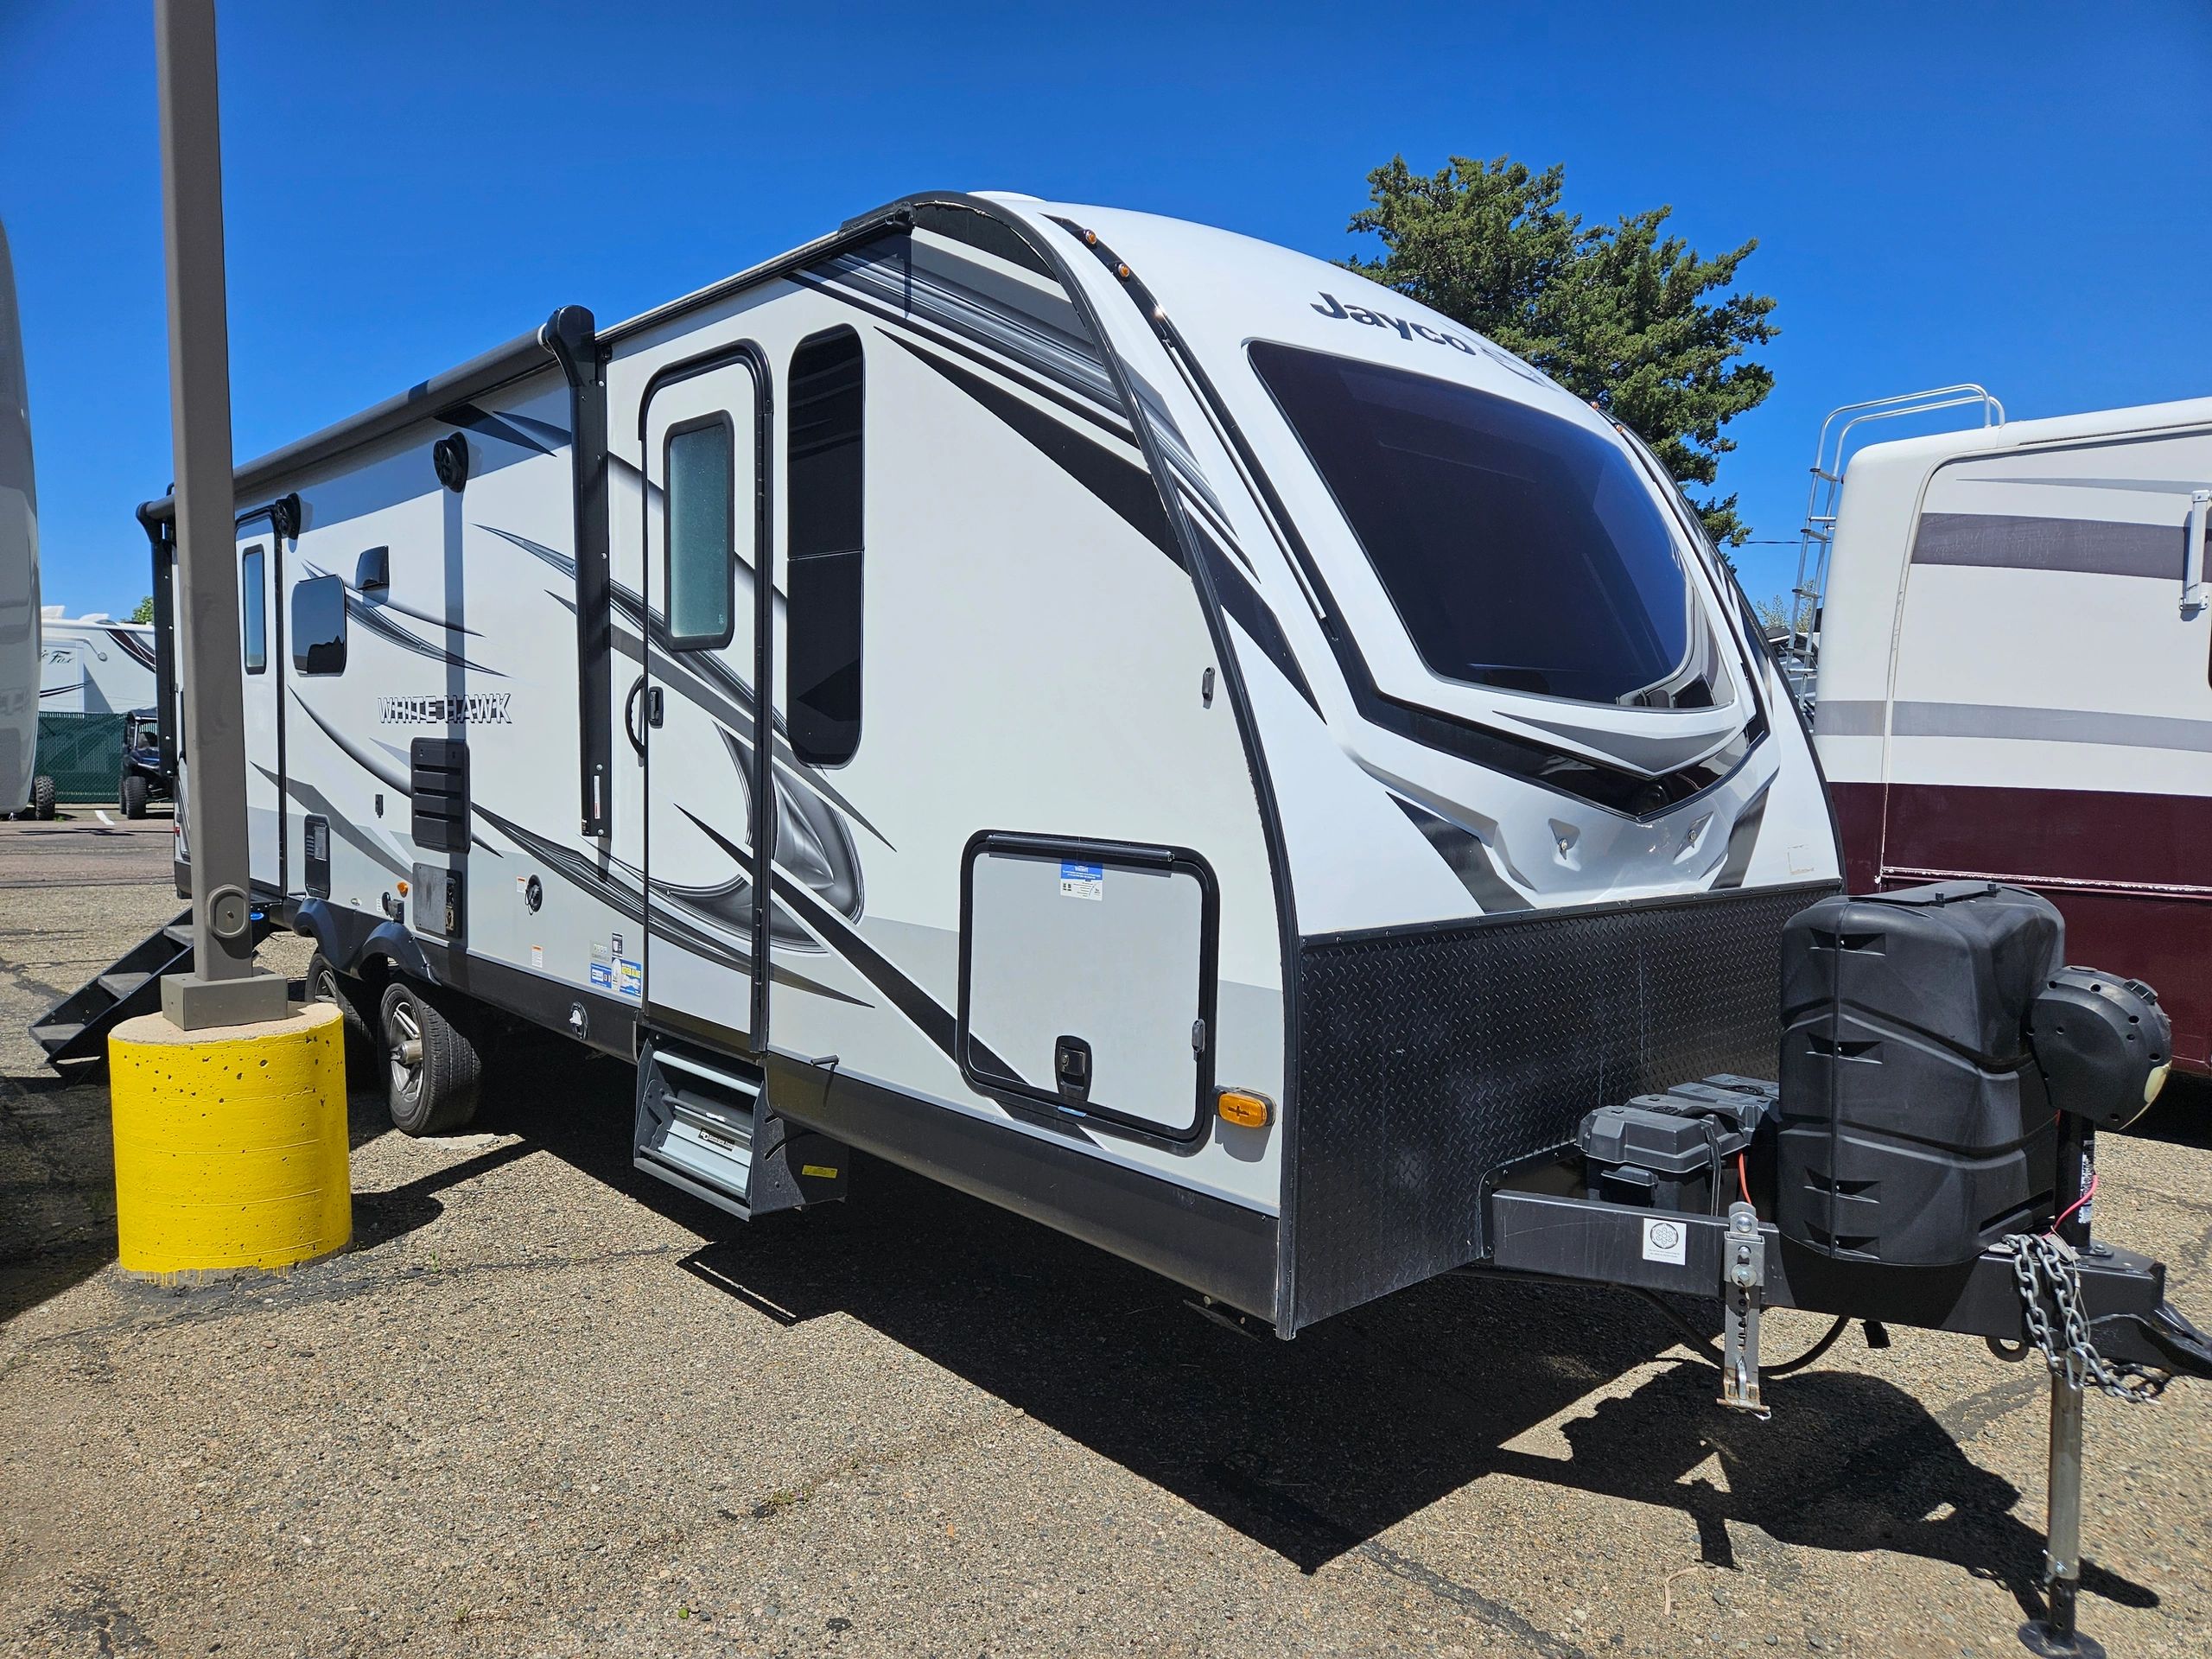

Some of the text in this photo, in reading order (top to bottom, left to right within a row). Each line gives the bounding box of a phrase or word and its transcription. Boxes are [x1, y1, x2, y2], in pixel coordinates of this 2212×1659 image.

[1310, 291, 1476, 356] Jayco
[378, 693, 512, 724] WHITE HAWK
